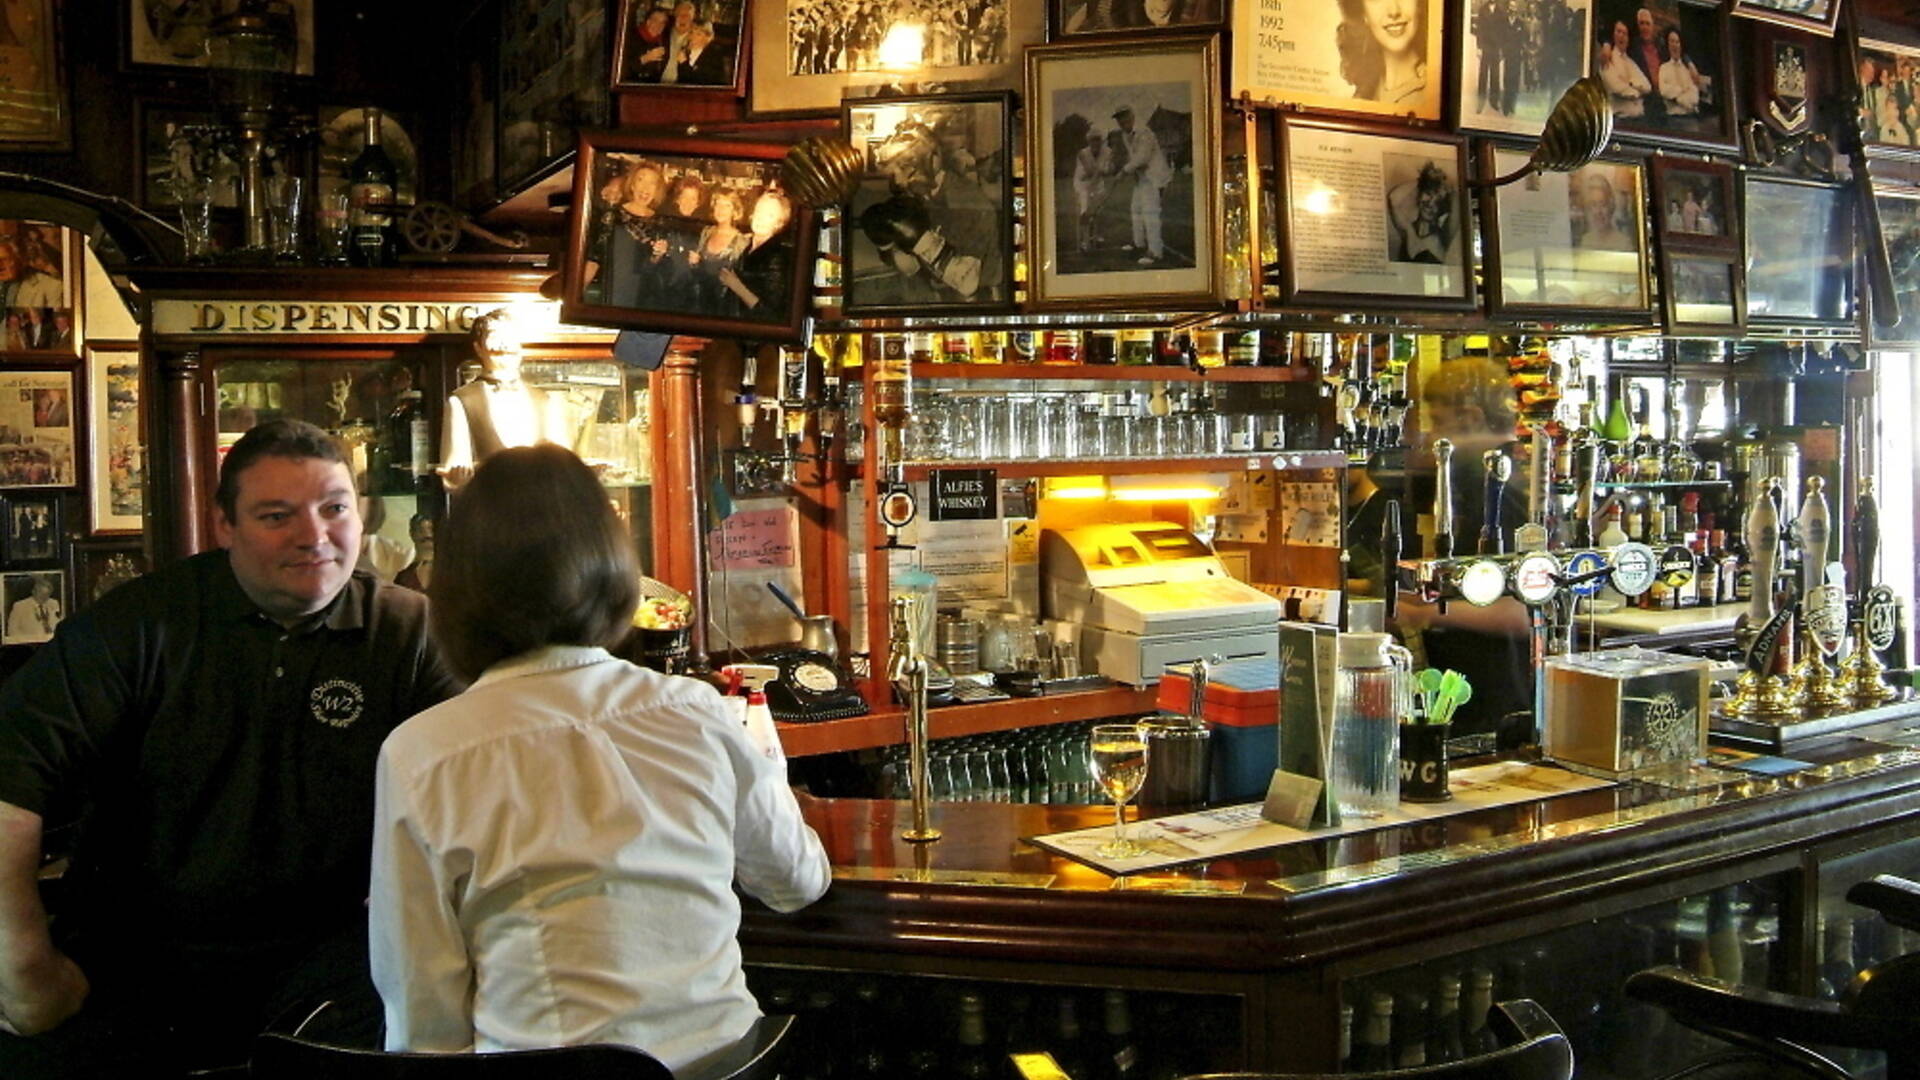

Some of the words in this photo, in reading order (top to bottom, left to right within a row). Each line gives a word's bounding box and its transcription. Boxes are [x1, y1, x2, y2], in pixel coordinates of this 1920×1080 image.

[1260, 16, 1284, 30] 1992
[190, 303, 481, 332] DISPENSING
[938, 495, 988, 510] WHISKEY
[1870, 604, 1896, 635] 6X
[1753, 608, 1793, 665] ADNAMS
